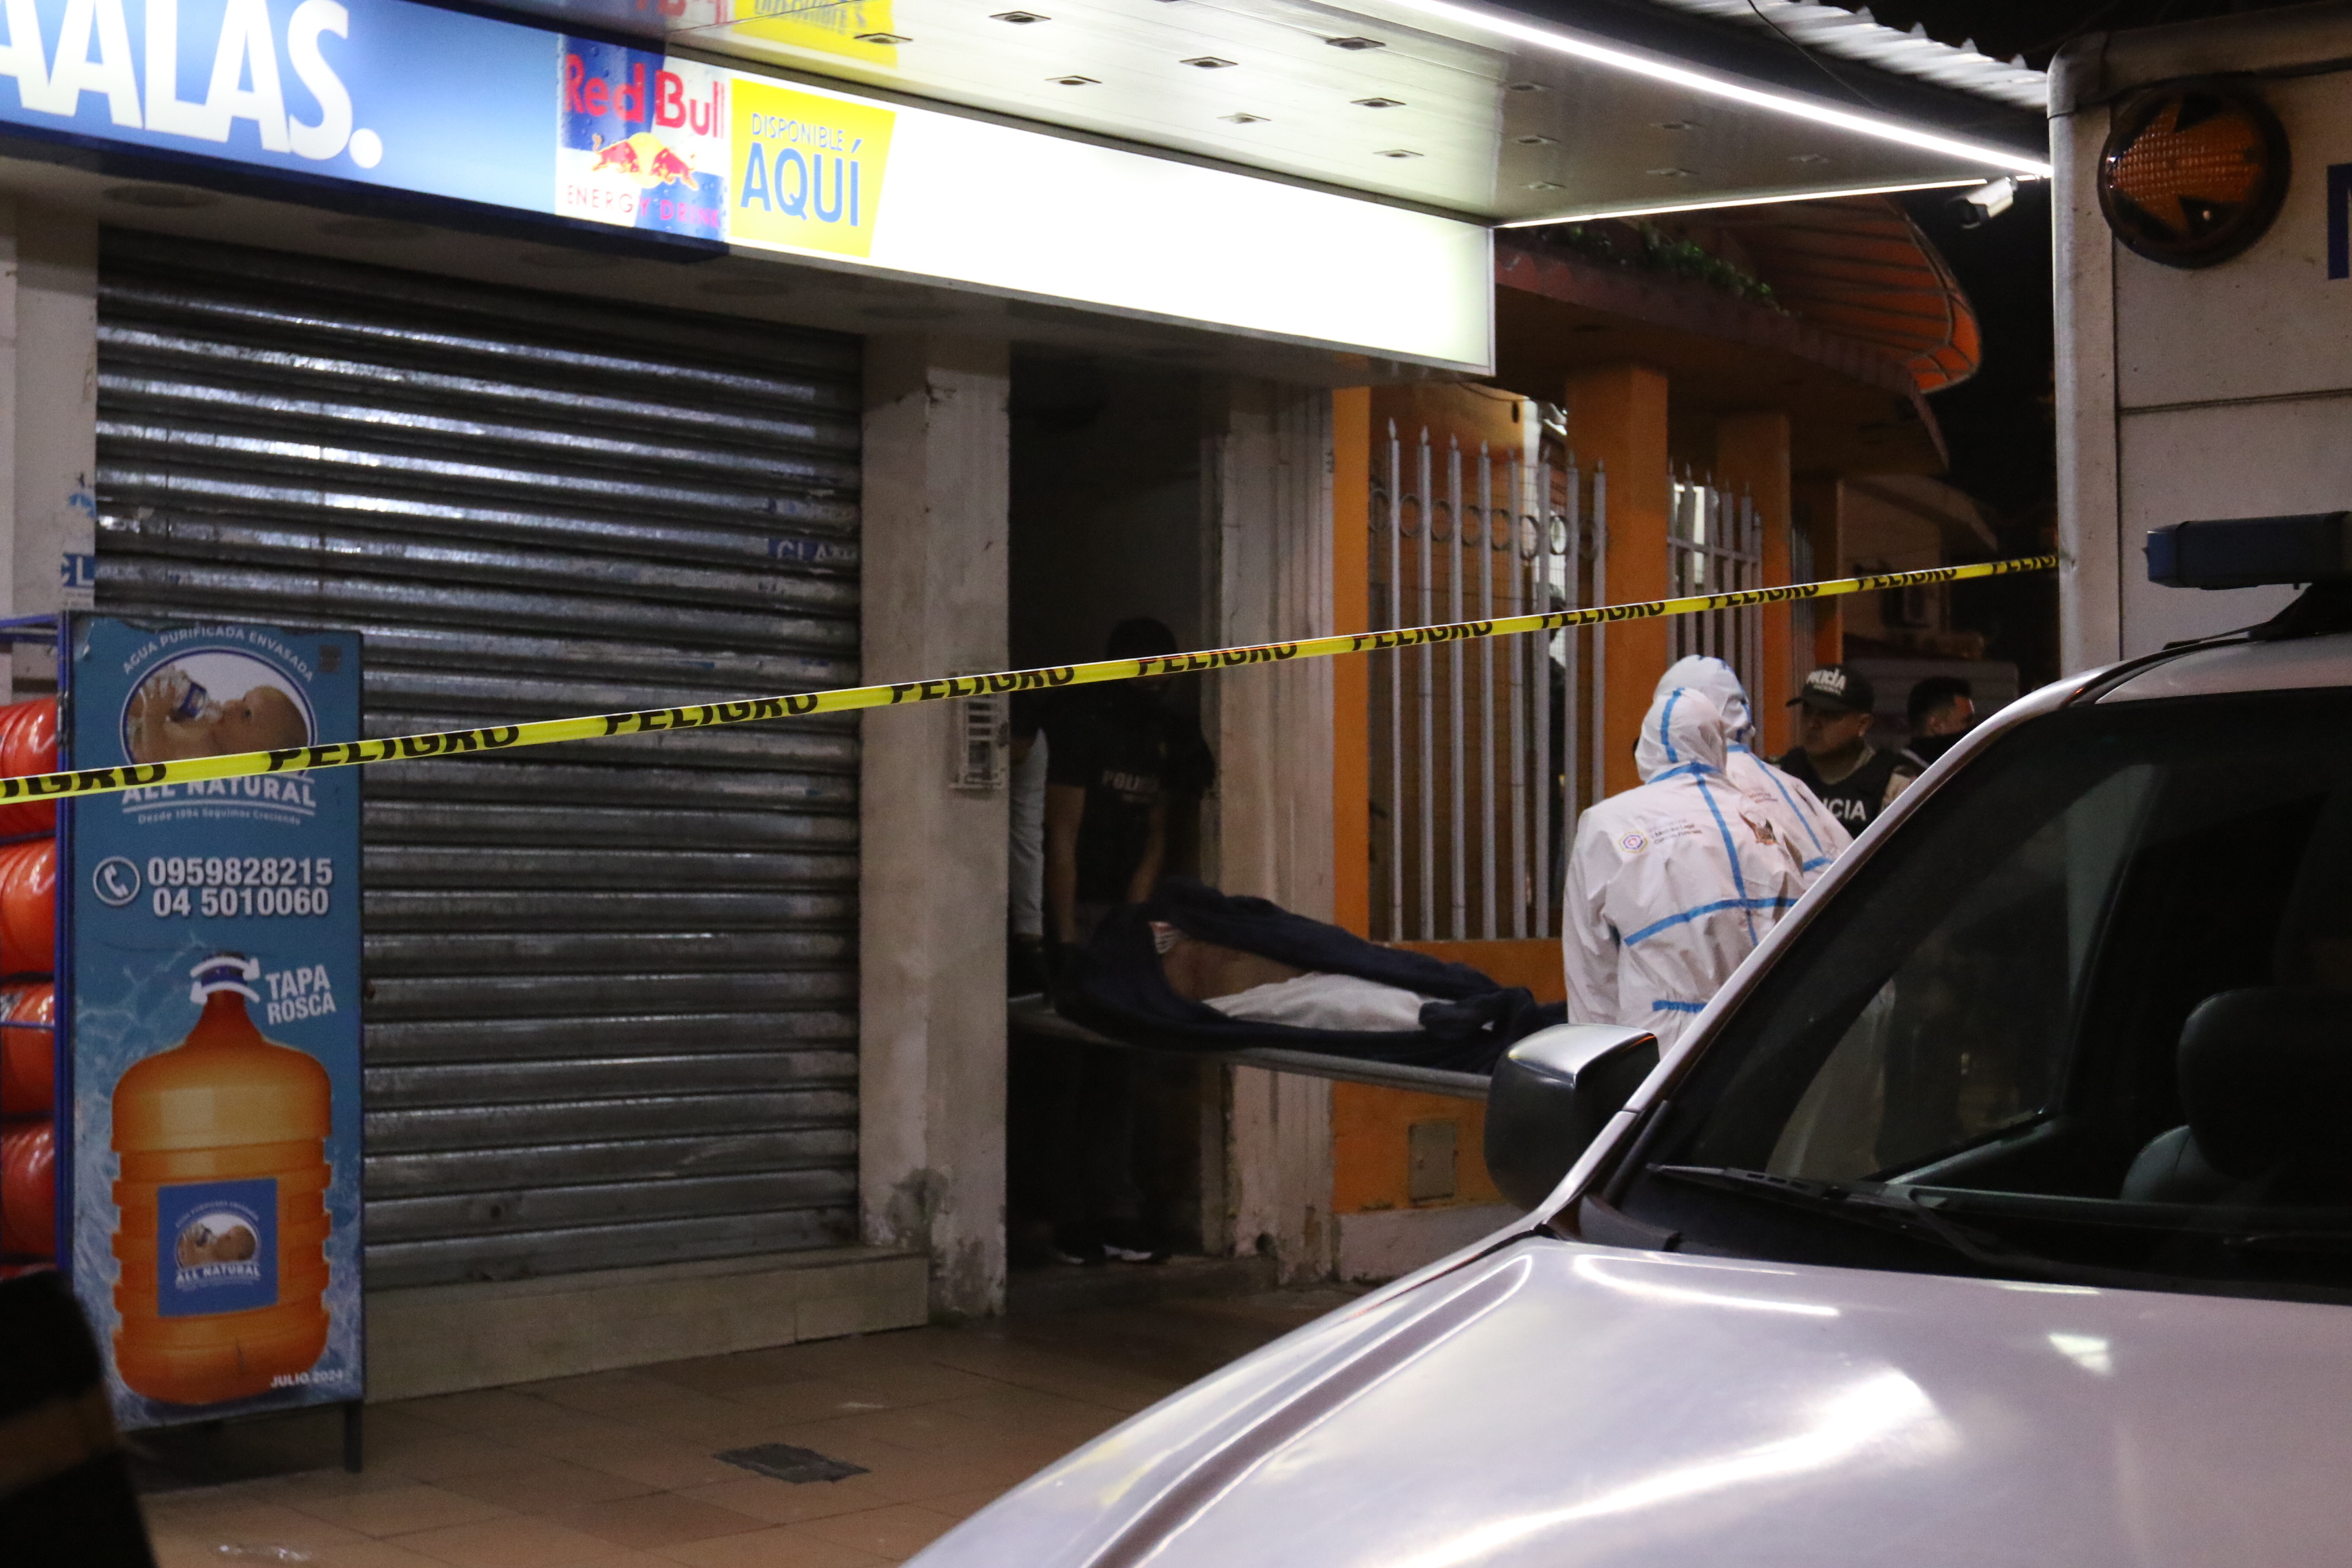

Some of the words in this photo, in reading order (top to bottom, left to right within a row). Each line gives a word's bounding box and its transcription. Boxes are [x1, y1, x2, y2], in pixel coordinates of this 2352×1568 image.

[565, 53, 645, 123] Red
[654, 69, 725, 139] Bull
[752, 112, 844, 152] DISPONIBLE
[740, 139, 863, 227] AQUÍ
[567, 184, 651, 217] ENERGY
[660, 200, 720, 228] DRINK
[122, 642, 158, 674] AGUA
[160, 625, 245, 645] PURIFICADA
[249, 631, 314, 682] ENVASADA
[122, 783, 175, 805] ALL
[188, 776, 316, 807] NATURAL
[138, 810, 172, 825] Desde
[148, 857, 333, 887] 0959828215
[153, 887, 191, 917] 04
[201, 887, 329, 916] 5010060
[265, 963, 331, 1001] TAPA
[267, 991, 337, 1025] ROSCA
[270, 1371, 310, 1388] JULIO
